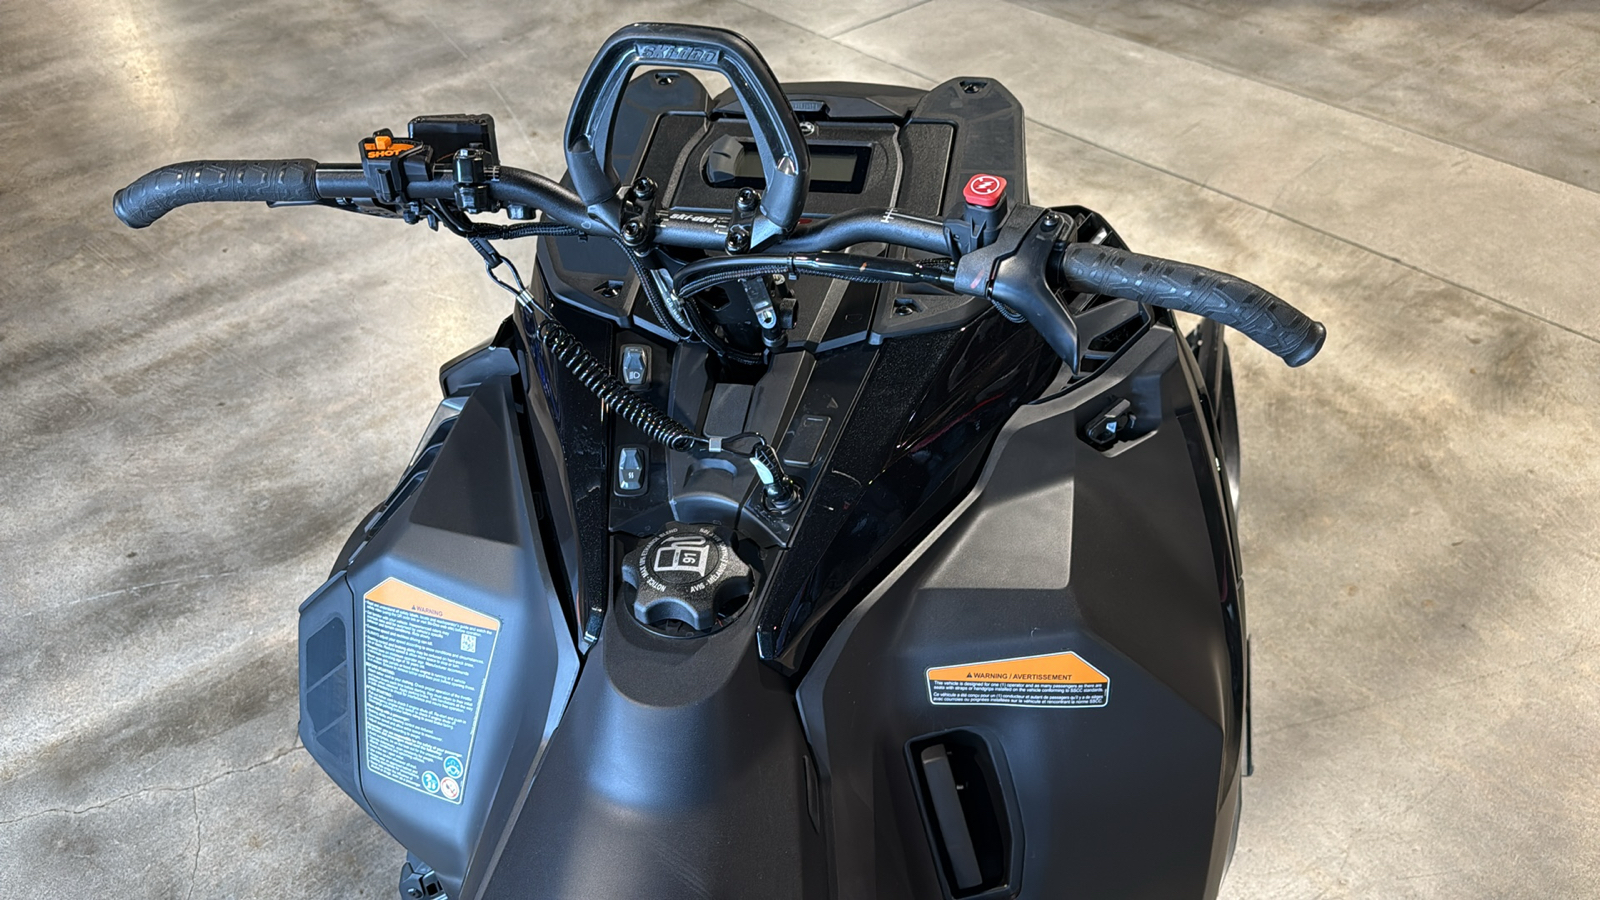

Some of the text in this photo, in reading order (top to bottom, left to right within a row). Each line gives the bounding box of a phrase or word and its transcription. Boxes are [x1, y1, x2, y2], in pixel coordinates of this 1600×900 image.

[368, 150, 401, 158] SHOT
[682, 552, 697, 564] 91
[646, 577, 666, 592] NOTICE
[690, 582, 706, 592] AVIS
[416, 606, 443, 616] WARNING
